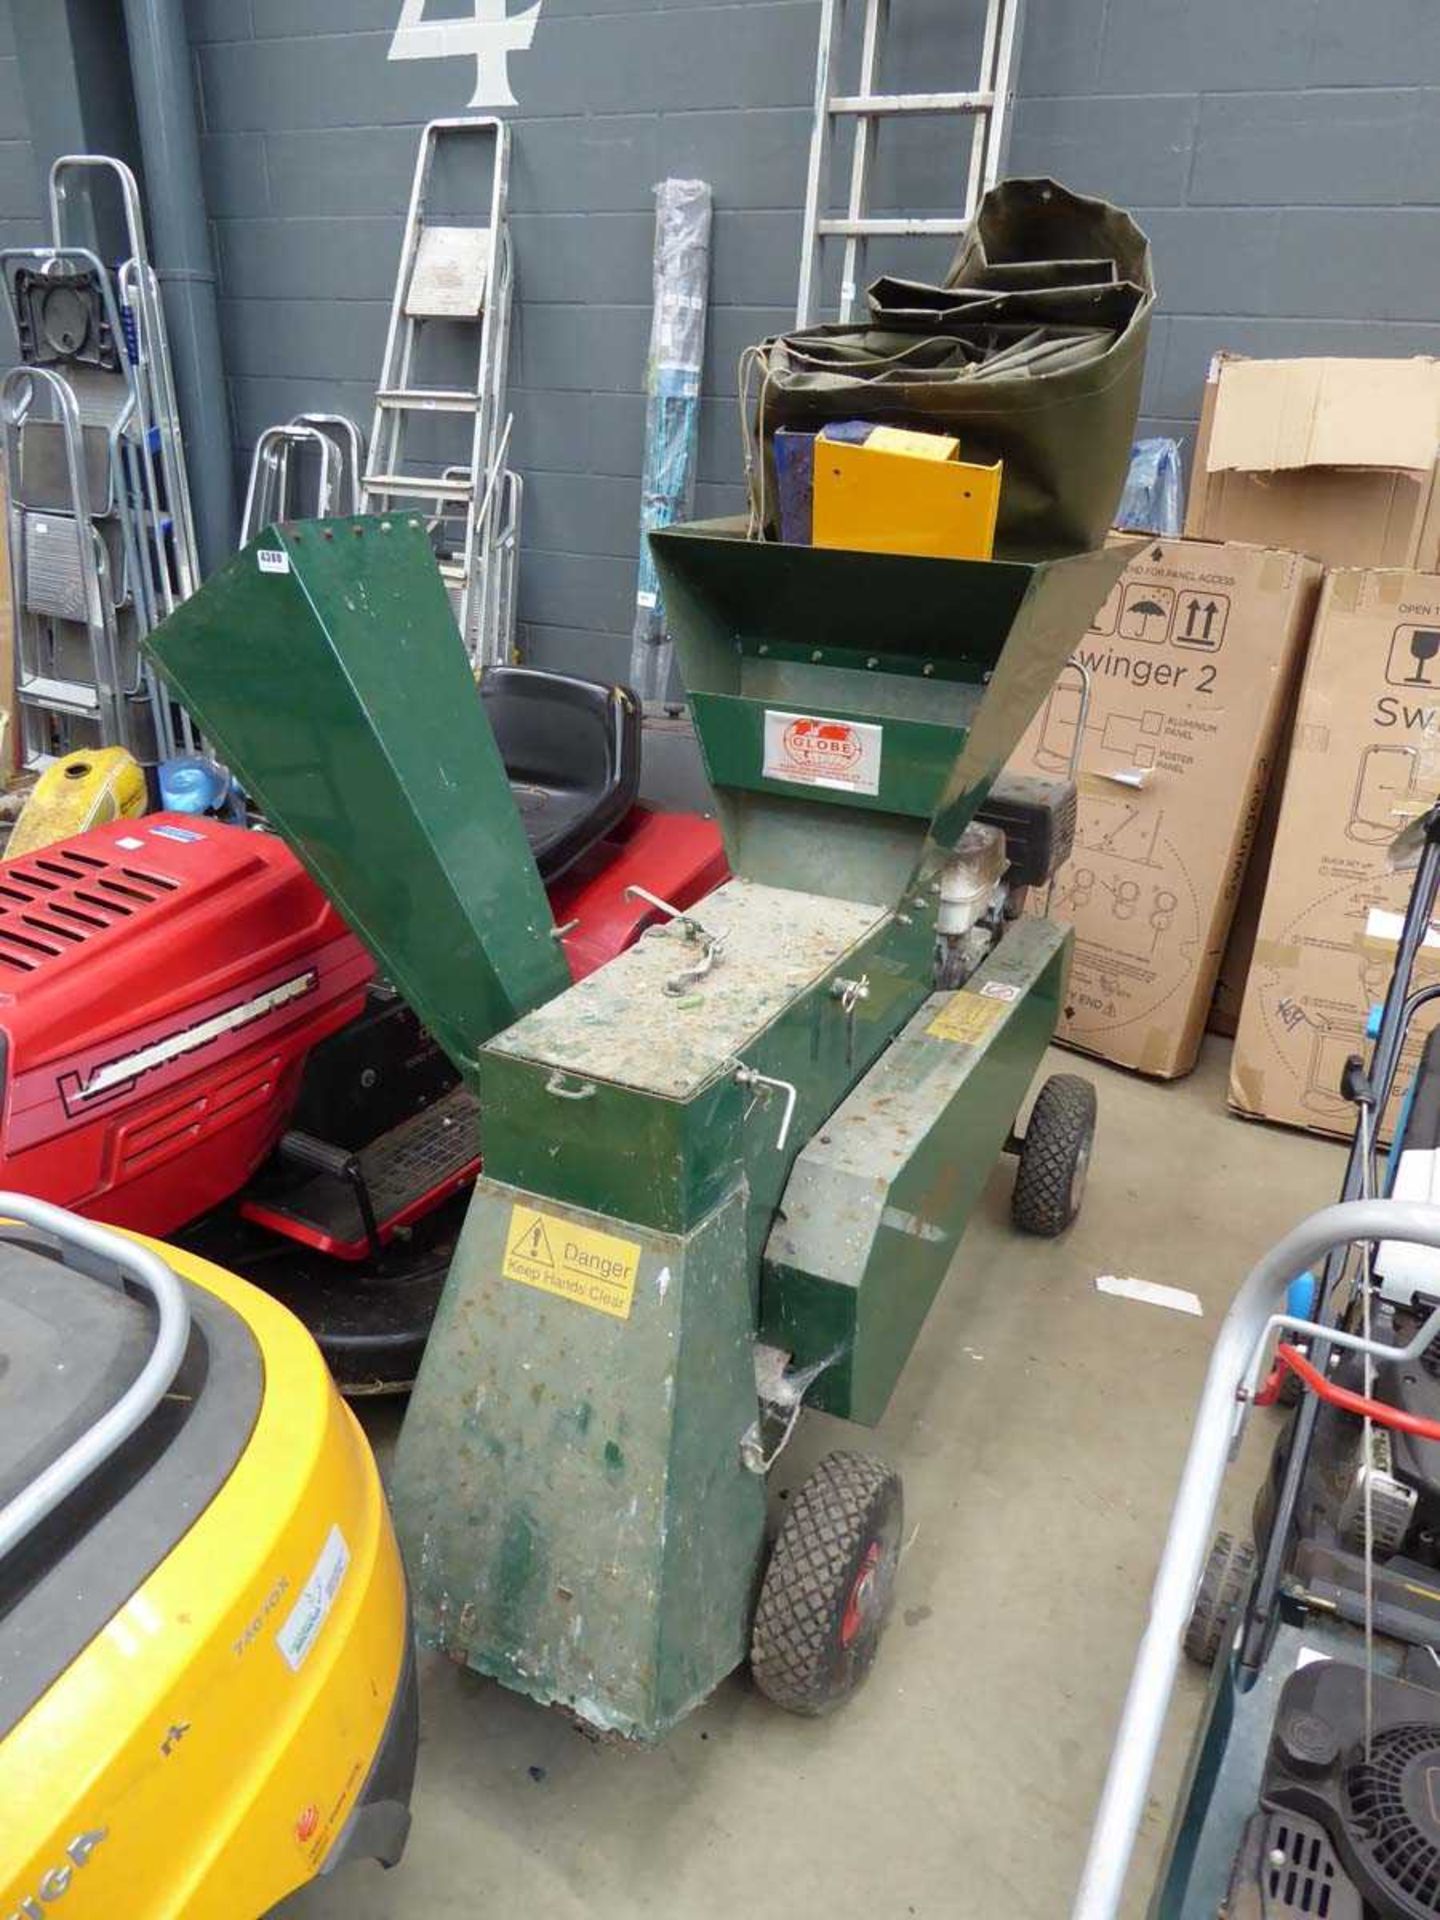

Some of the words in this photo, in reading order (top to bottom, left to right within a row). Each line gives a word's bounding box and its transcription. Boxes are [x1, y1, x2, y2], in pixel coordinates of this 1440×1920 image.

[1199, 574, 1236, 586] ACCESS
[1398, 603, 1431, 615] OPEN
[1071, 649, 1188, 687] winger
[1195, 664, 1217, 694] 2
[1373, 697, 1440, 730] Sw
[793, 736, 852, 754] GLOBE
[1079, 993, 1104, 1010] END
[564, 1242, 633, 1279] Danger
[509, 1258, 541, 1281] Keep
[543, 1270, 585, 1295] Hands
[589, 1286, 624, 1309] Clear
[4, 1826, 109, 1920] IGA
